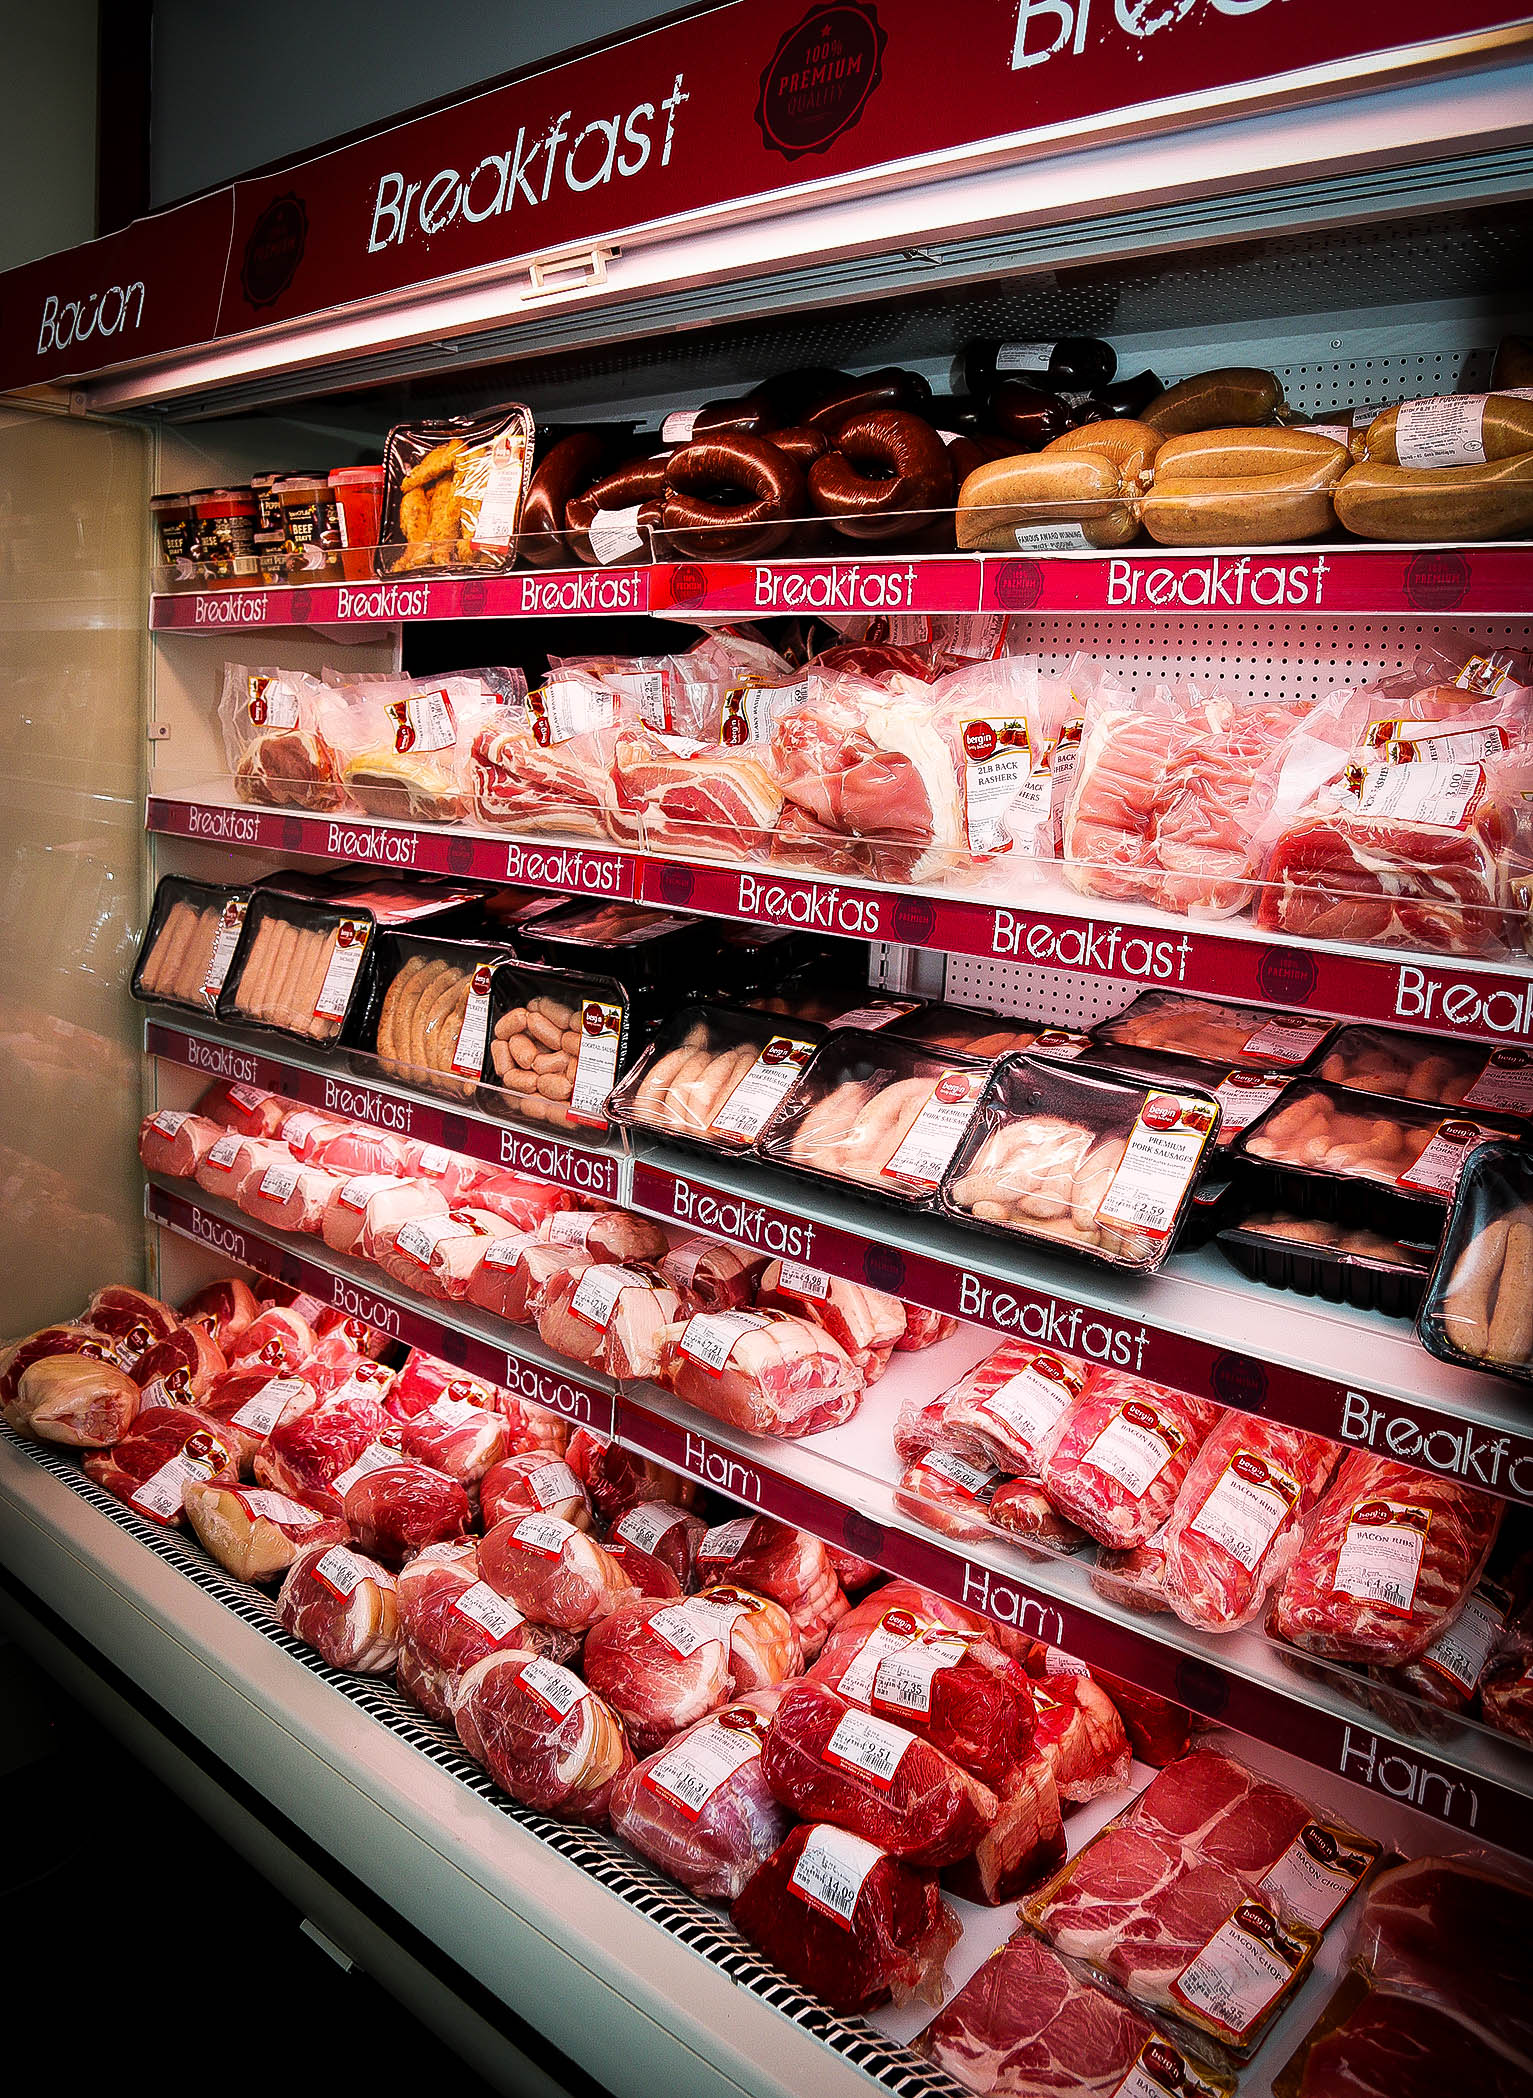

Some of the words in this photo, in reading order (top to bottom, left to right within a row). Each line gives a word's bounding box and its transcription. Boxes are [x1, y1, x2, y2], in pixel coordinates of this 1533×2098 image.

[778, 52, 864, 97] PREMIUM
[366, 73, 690, 254] Breakfast
[37, 280, 146, 355] Bacon
[1438, 395, 1470, 405] PUDDING
[292, 523, 314, 536] BEEF
[1017, 533, 1039, 545] FAMOUS
[1040, 531, 1059, 542] AWARD
[1059, 530, 1082, 540] WINNING
[521, 571, 642, 612] Breakfast
[755, 564, 918, 607] Breakfast
[1106, 554, 1330, 607] Breakfast
[194, 591, 269, 625] Breakfast
[336, 584, 430, 620] Breakfast
[966, 732, 992, 745] bergin
[977, 765, 994, 775] 2LB
[994, 761, 1019, 772] BACK
[1057, 753, 1077, 764] BACK
[977, 772, 1018, 786] RASHERS
[188, 806, 261, 841] Breakfast
[327, 824, 419, 864] Breakfast
[506, 845, 624, 891] Breakfast
[738, 874, 880, 933] Breakfas
[993, 910, 1194, 982] Breakfast
[187, 1038, 259, 1082] Breakfast
[768, 1046, 788, 1056] bergin
[761, 1068, 788, 1080] PREMIUM
[1234, 1074, 1261, 1083] bergin
[941, 1081, 966, 1094] bergin
[325, 1079, 414, 1132] Breakfast
[922, 1111, 939, 1121] PORK
[937, 1107, 969, 1119] PREMIUM
[1149, 1104, 1176, 1118] bergin
[1446, 1126, 1477, 1138] bergin
[1131, 1141, 1153, 1154] PORK
[1153, 1147, 1194, 1163] SAUSAGES
[1148, 1136, 1187, 1153] PREMIUM
[500, 1130, 615, 1193] Breakfast
[672, 1179, 817, 1261] Breakfast
[1133, 1201, 1165, 1217] £2.59
[191, 1206, 246, 1259] Bacon
[333, 1277, 401, 1335] Bacon
[959, 1272, 1152, 1371] Breakfast
[1037, 1358, 1060, 1378] bergin
[505, 1355, 592, 1423] Bacon
[1129, 1404, 1155, 1424] bergin
[1120, 1424, 1147, 1444] BACON
[684, 1432, 762, 1503] Ham
[1237, 1458, 1266, 1478] bergin
[1230, 1480, 1258, 1503] BACON
[1259, 1500, 1278, 1516] RIBS
[1358, 1509, 1388, 1519] bergin
[1356, 1531, 1390, 1544] BACON
[1392, 1537, 1415, 1548] RIBS
[1366, 1580, 1401, 1594] £4.61
[962, 1562, 1064, 1645] Ham
[888, 1614, 912, 1631] bergin
[941, 1650, 959, 1663] BEEF
[546, 1676, 573, 1697] £8.00
[897, 1680, 923, 1695] £7.35
[861, 1739, 891, 1761] £9.51
[677, 1772, 709, 1797] £16.31
[1340, 1725, 1479, 1829] Ham
[1309, 1829, 1333, 1855] bergin
[1296, 1850, 1322, 1880] BACON
[1321, 1877, 1350, 1894] CHOPS
[820, 1873, 855, 1902] £14.09
[1243, 1909, 1271, 1931] bergin
[1229, 1930, 1259, 1957] BACON
[1258, 1956, 1288, 1984] CHOPS
[1151, 2048, 1180, 2079] bergin
